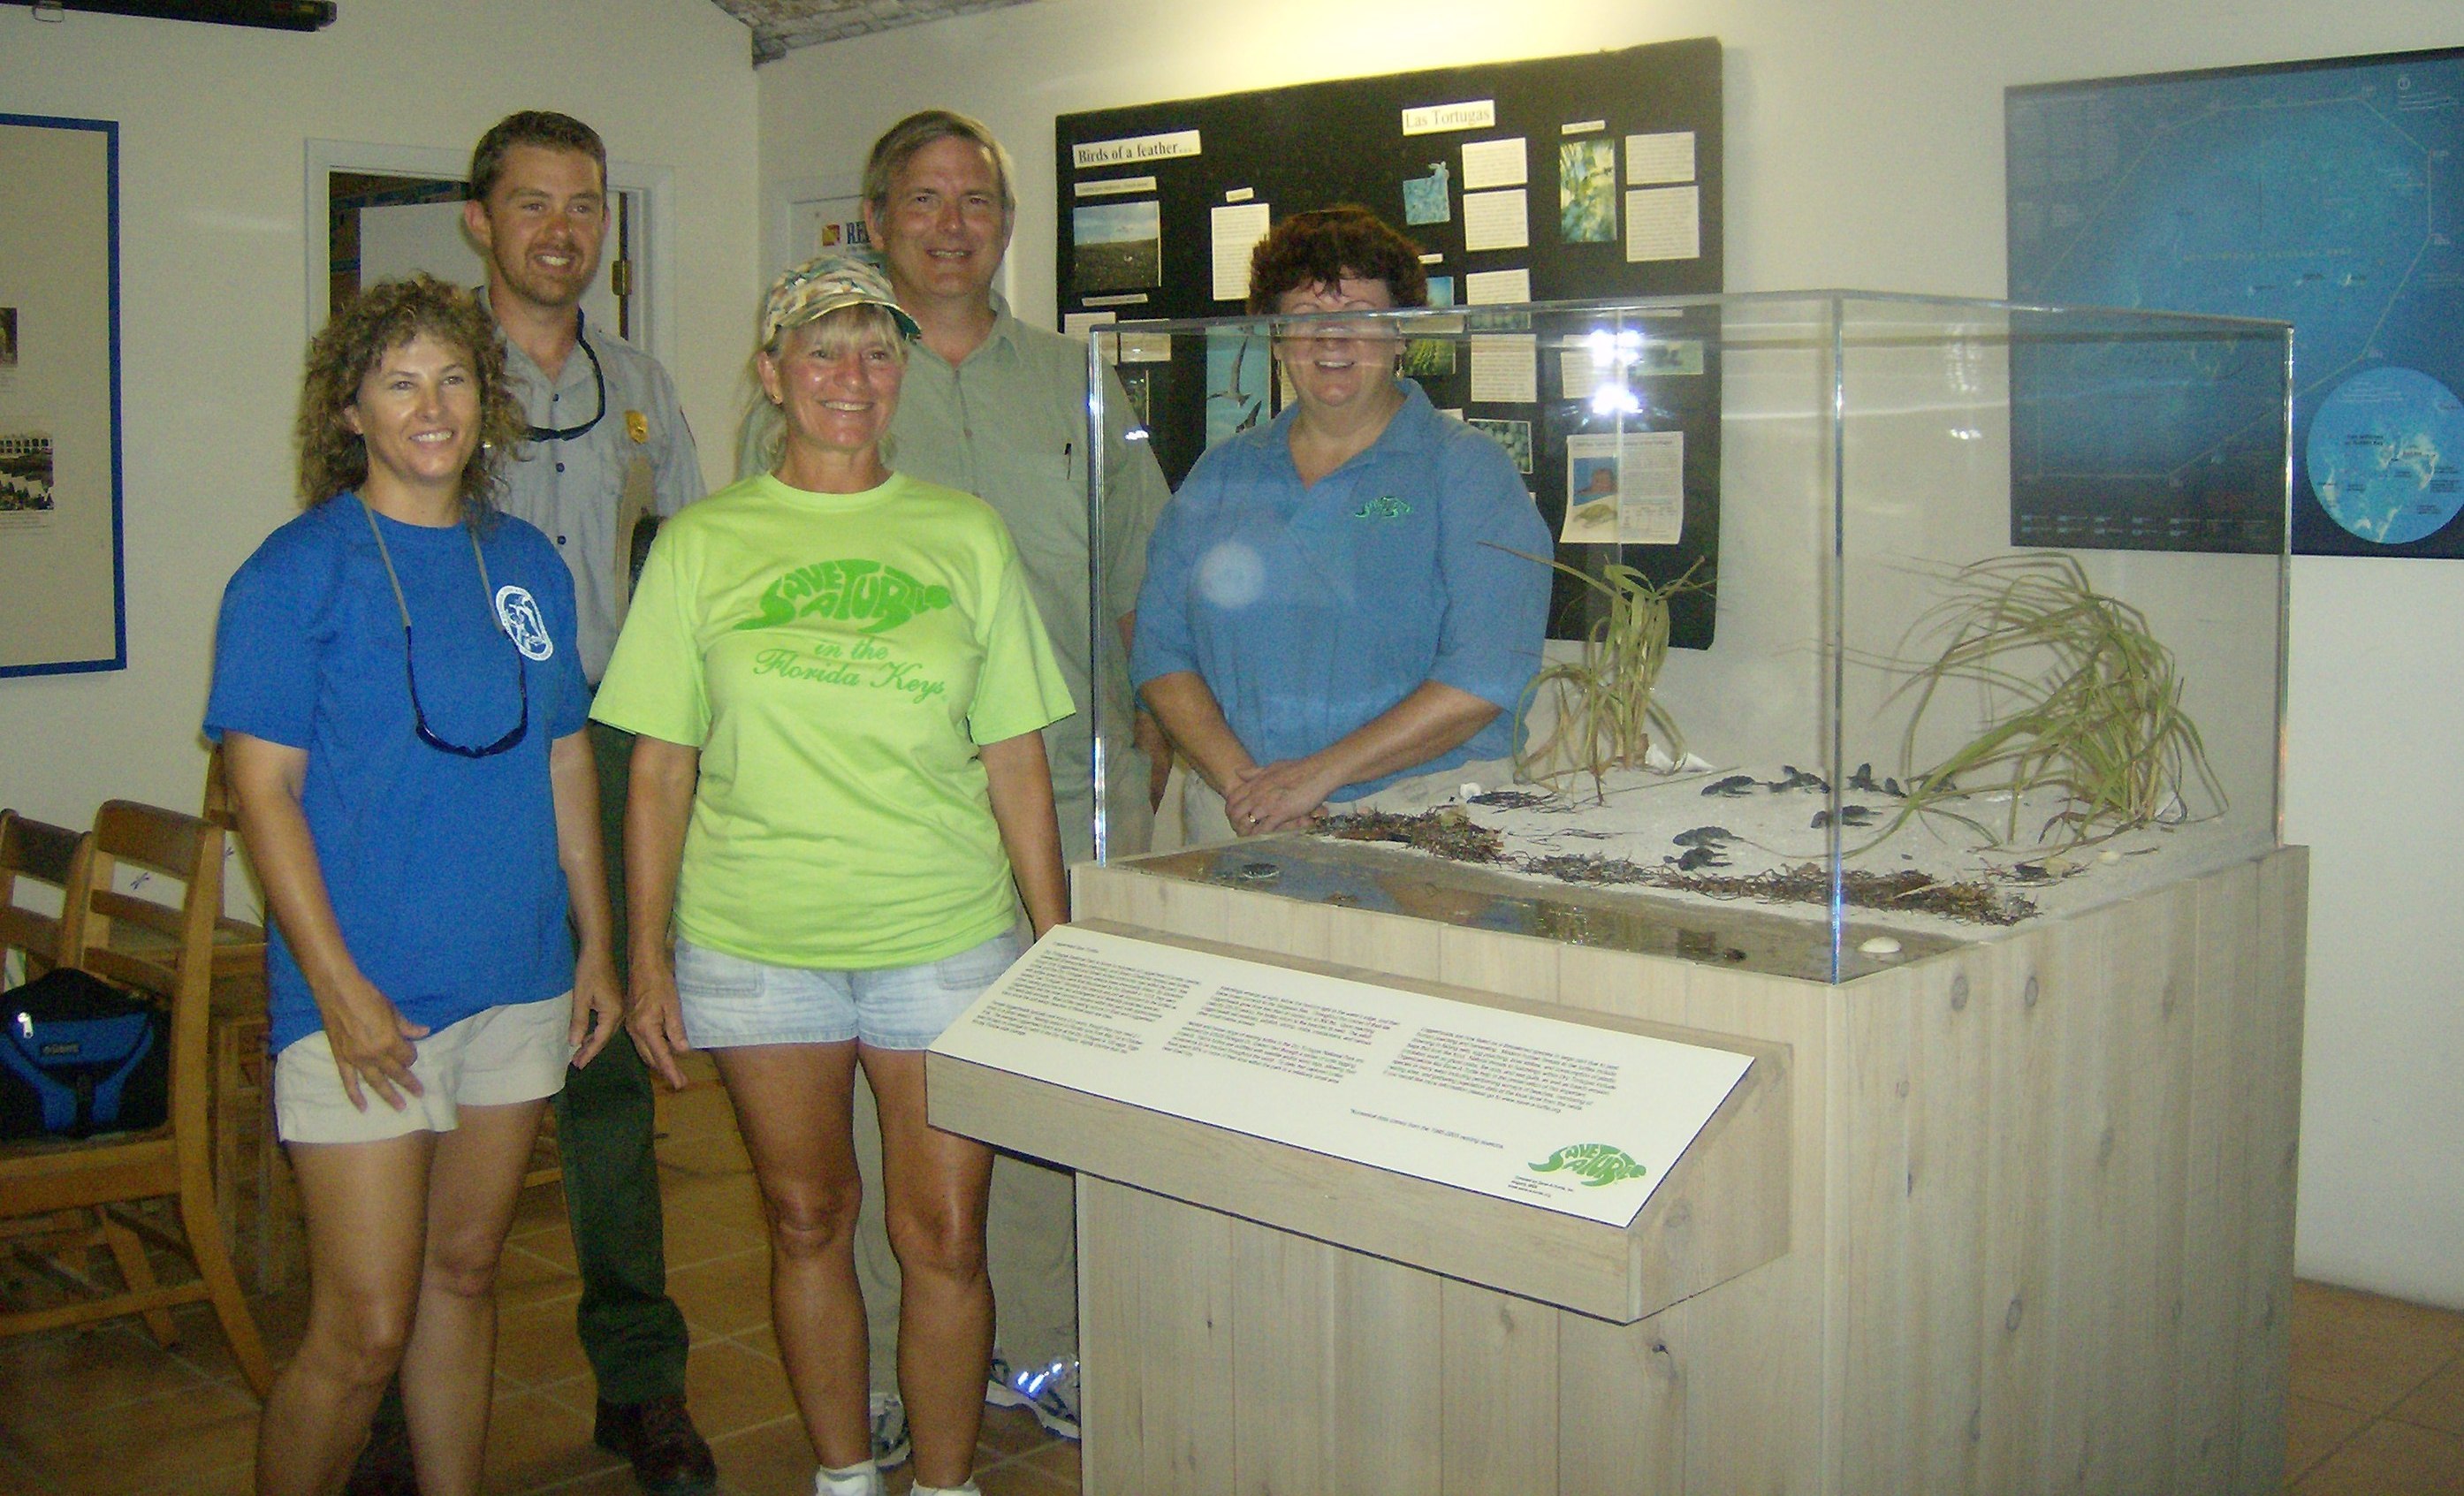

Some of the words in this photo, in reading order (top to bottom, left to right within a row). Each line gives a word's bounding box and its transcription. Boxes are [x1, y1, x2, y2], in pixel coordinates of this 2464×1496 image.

[1405, 113, 1428, 128] Las
[1432, 108, 1490, 125] Tortugas
[1077, 149, 1108, 164] Birds
[1111, 149, 1123, 160] of
[733, 560, 845, 630] SAVE
[800, 592, 839, 619] A
[814, 640, 842, 658] in
[851, 637, 889, 659] the
[753, 649, 861, 686] Florida
[870, 661, 946, 704] Keys
